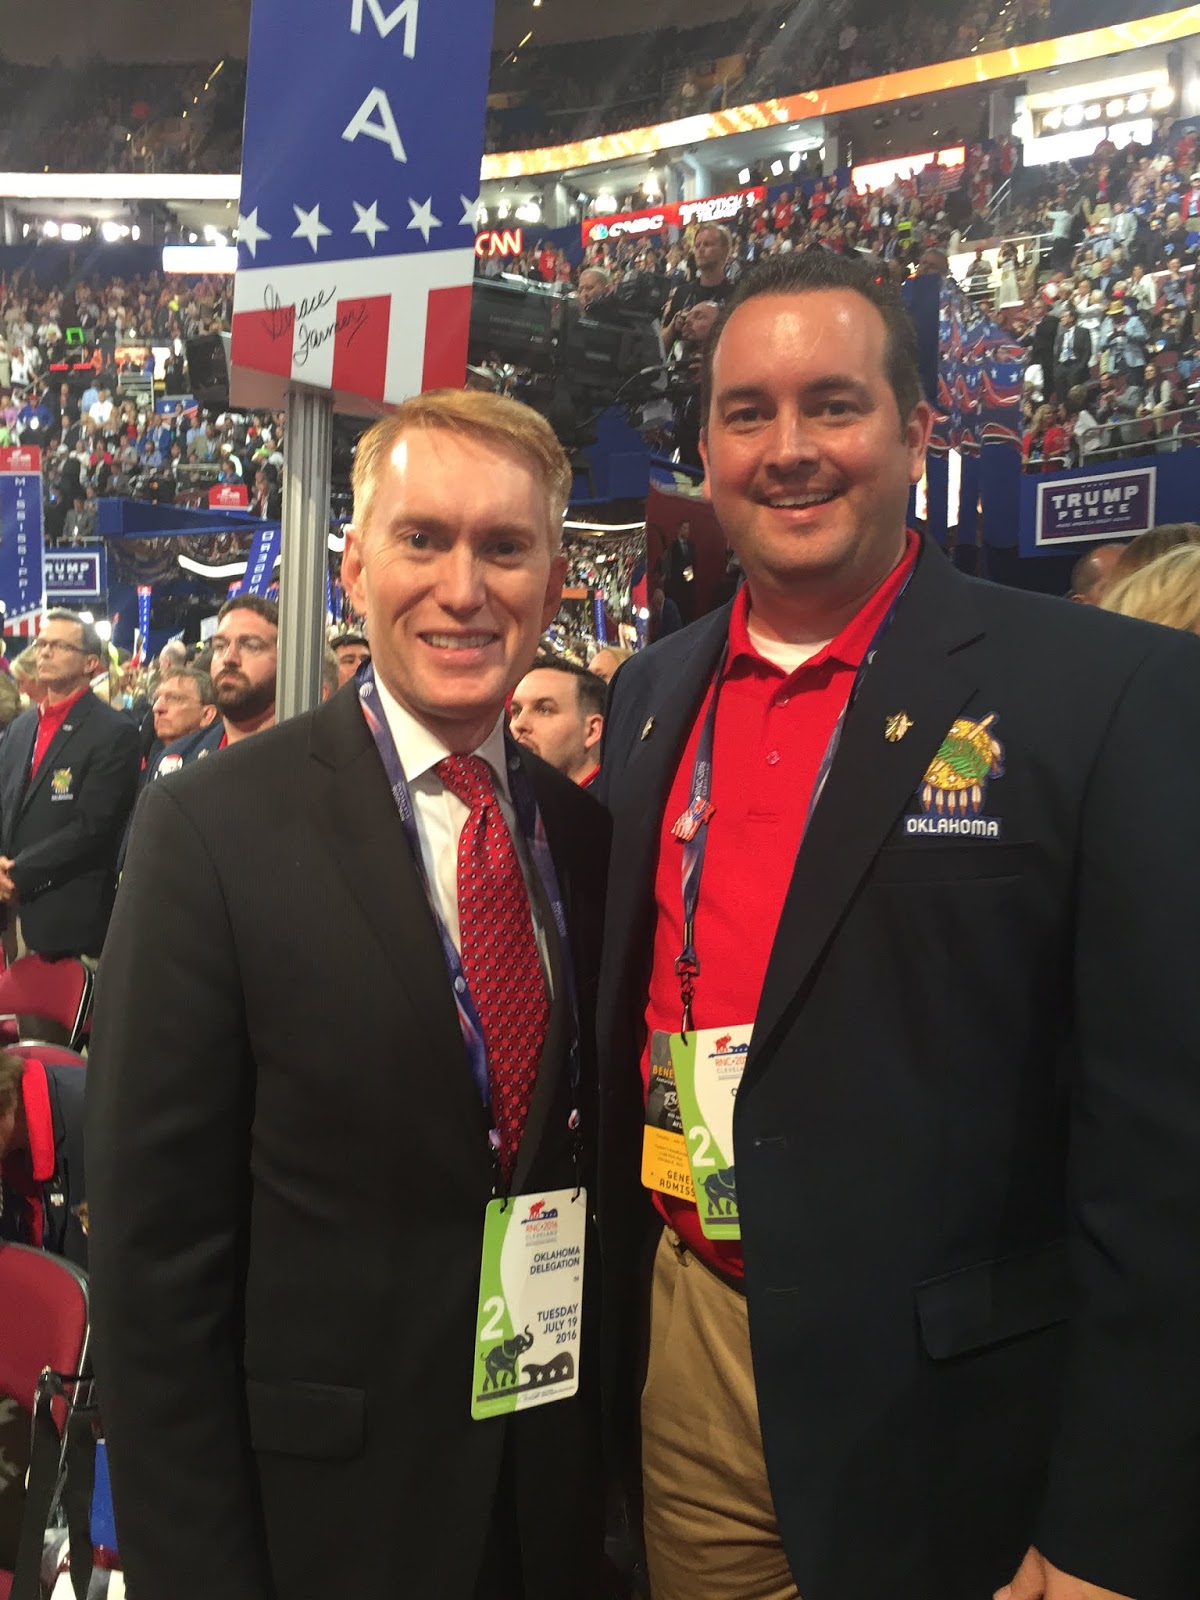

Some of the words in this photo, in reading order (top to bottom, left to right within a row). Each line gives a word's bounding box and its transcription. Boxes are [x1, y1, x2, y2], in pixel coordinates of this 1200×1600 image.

[475, 229, 523, 257] CNN
[1051, 485, 1139, 509] TRUMP
[1058, 503, 1130, 520] PENCE
[45, 562, 89, 574] RUMP
[906, 818, 998, 837] OKLAHOMA
[688, 1125, 716, 1167] 2
[659, 1178, 696, 1197] ADMISS
[667, 1170, 694, 1186] GENE
[533, 1246, 580, 1263] OKLAHOMA
[530, 1257, 580, 1275] DELEGATION
[480, 1295, 505, 1342] 2
[536, 1303, 578, 1322] TUESDAY
[543, 1320, 565, 1335] JULY
[567, 1316, 578, 1328] 19
[555, 1329, 577, 1345] 2016
